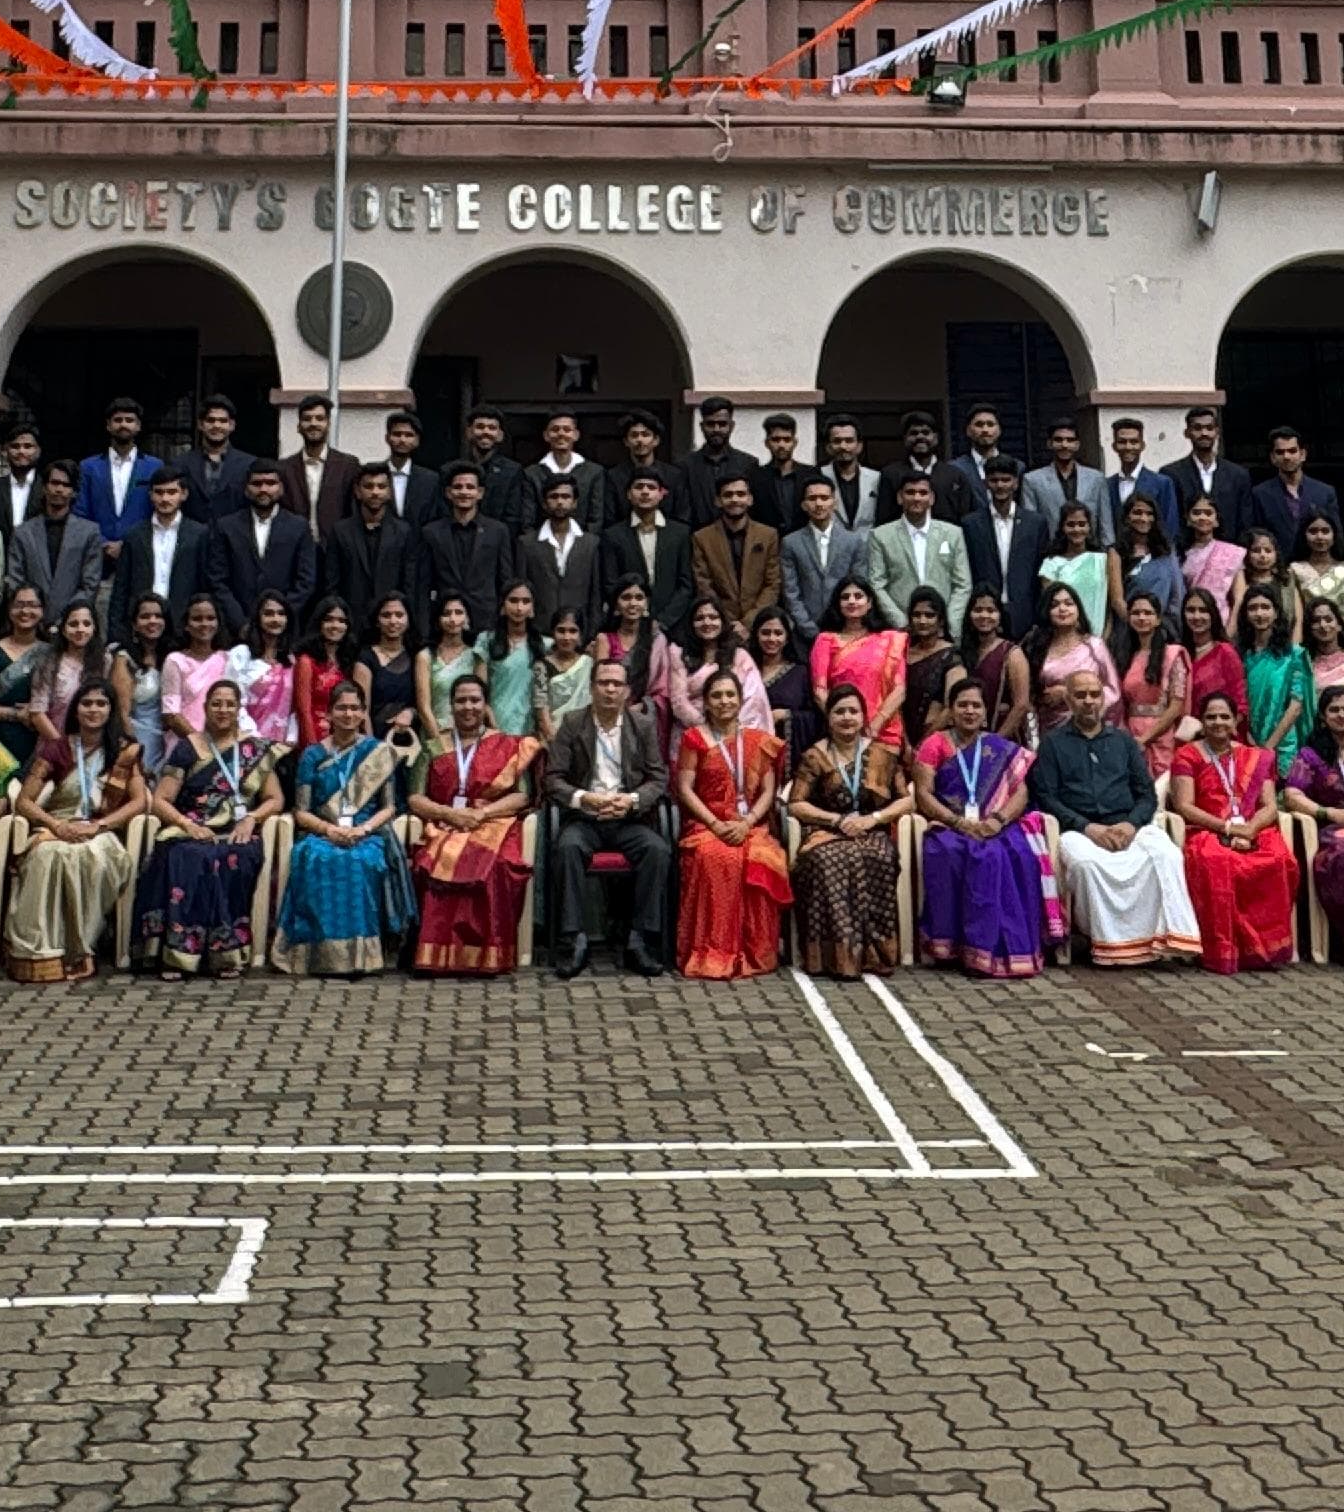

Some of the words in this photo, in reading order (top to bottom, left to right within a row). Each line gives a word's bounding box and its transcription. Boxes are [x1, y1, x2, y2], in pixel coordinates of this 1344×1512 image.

[507, 183, 723, 231] COLLEGE
[749, 184, 806, 235] OF
[832, 185, 1110, 237] COMMERCE
